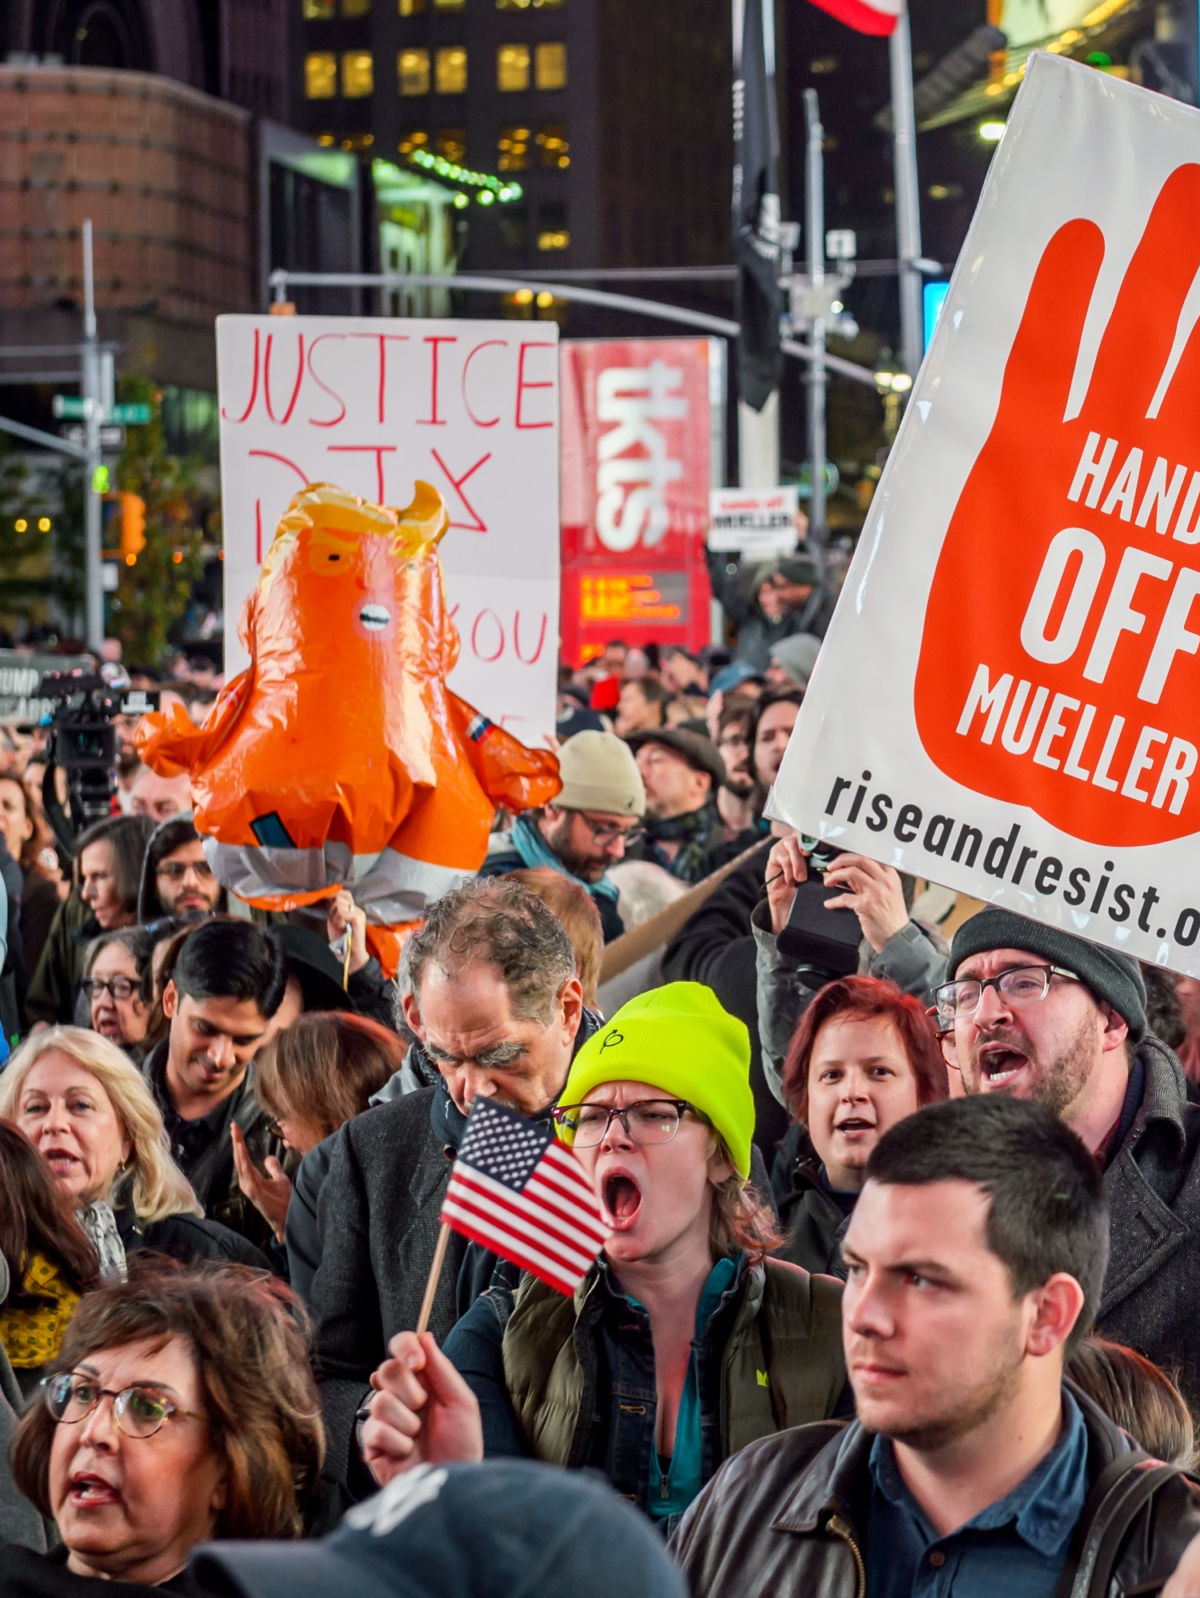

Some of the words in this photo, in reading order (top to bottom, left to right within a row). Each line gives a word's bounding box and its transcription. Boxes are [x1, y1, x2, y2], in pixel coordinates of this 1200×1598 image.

[222, 329, 555, 428] JUSTICE
[595, 358, 690, 552] tkts
[449, 603, 548, 664] OU
[955, 663, 1199, 816] MUELLER
